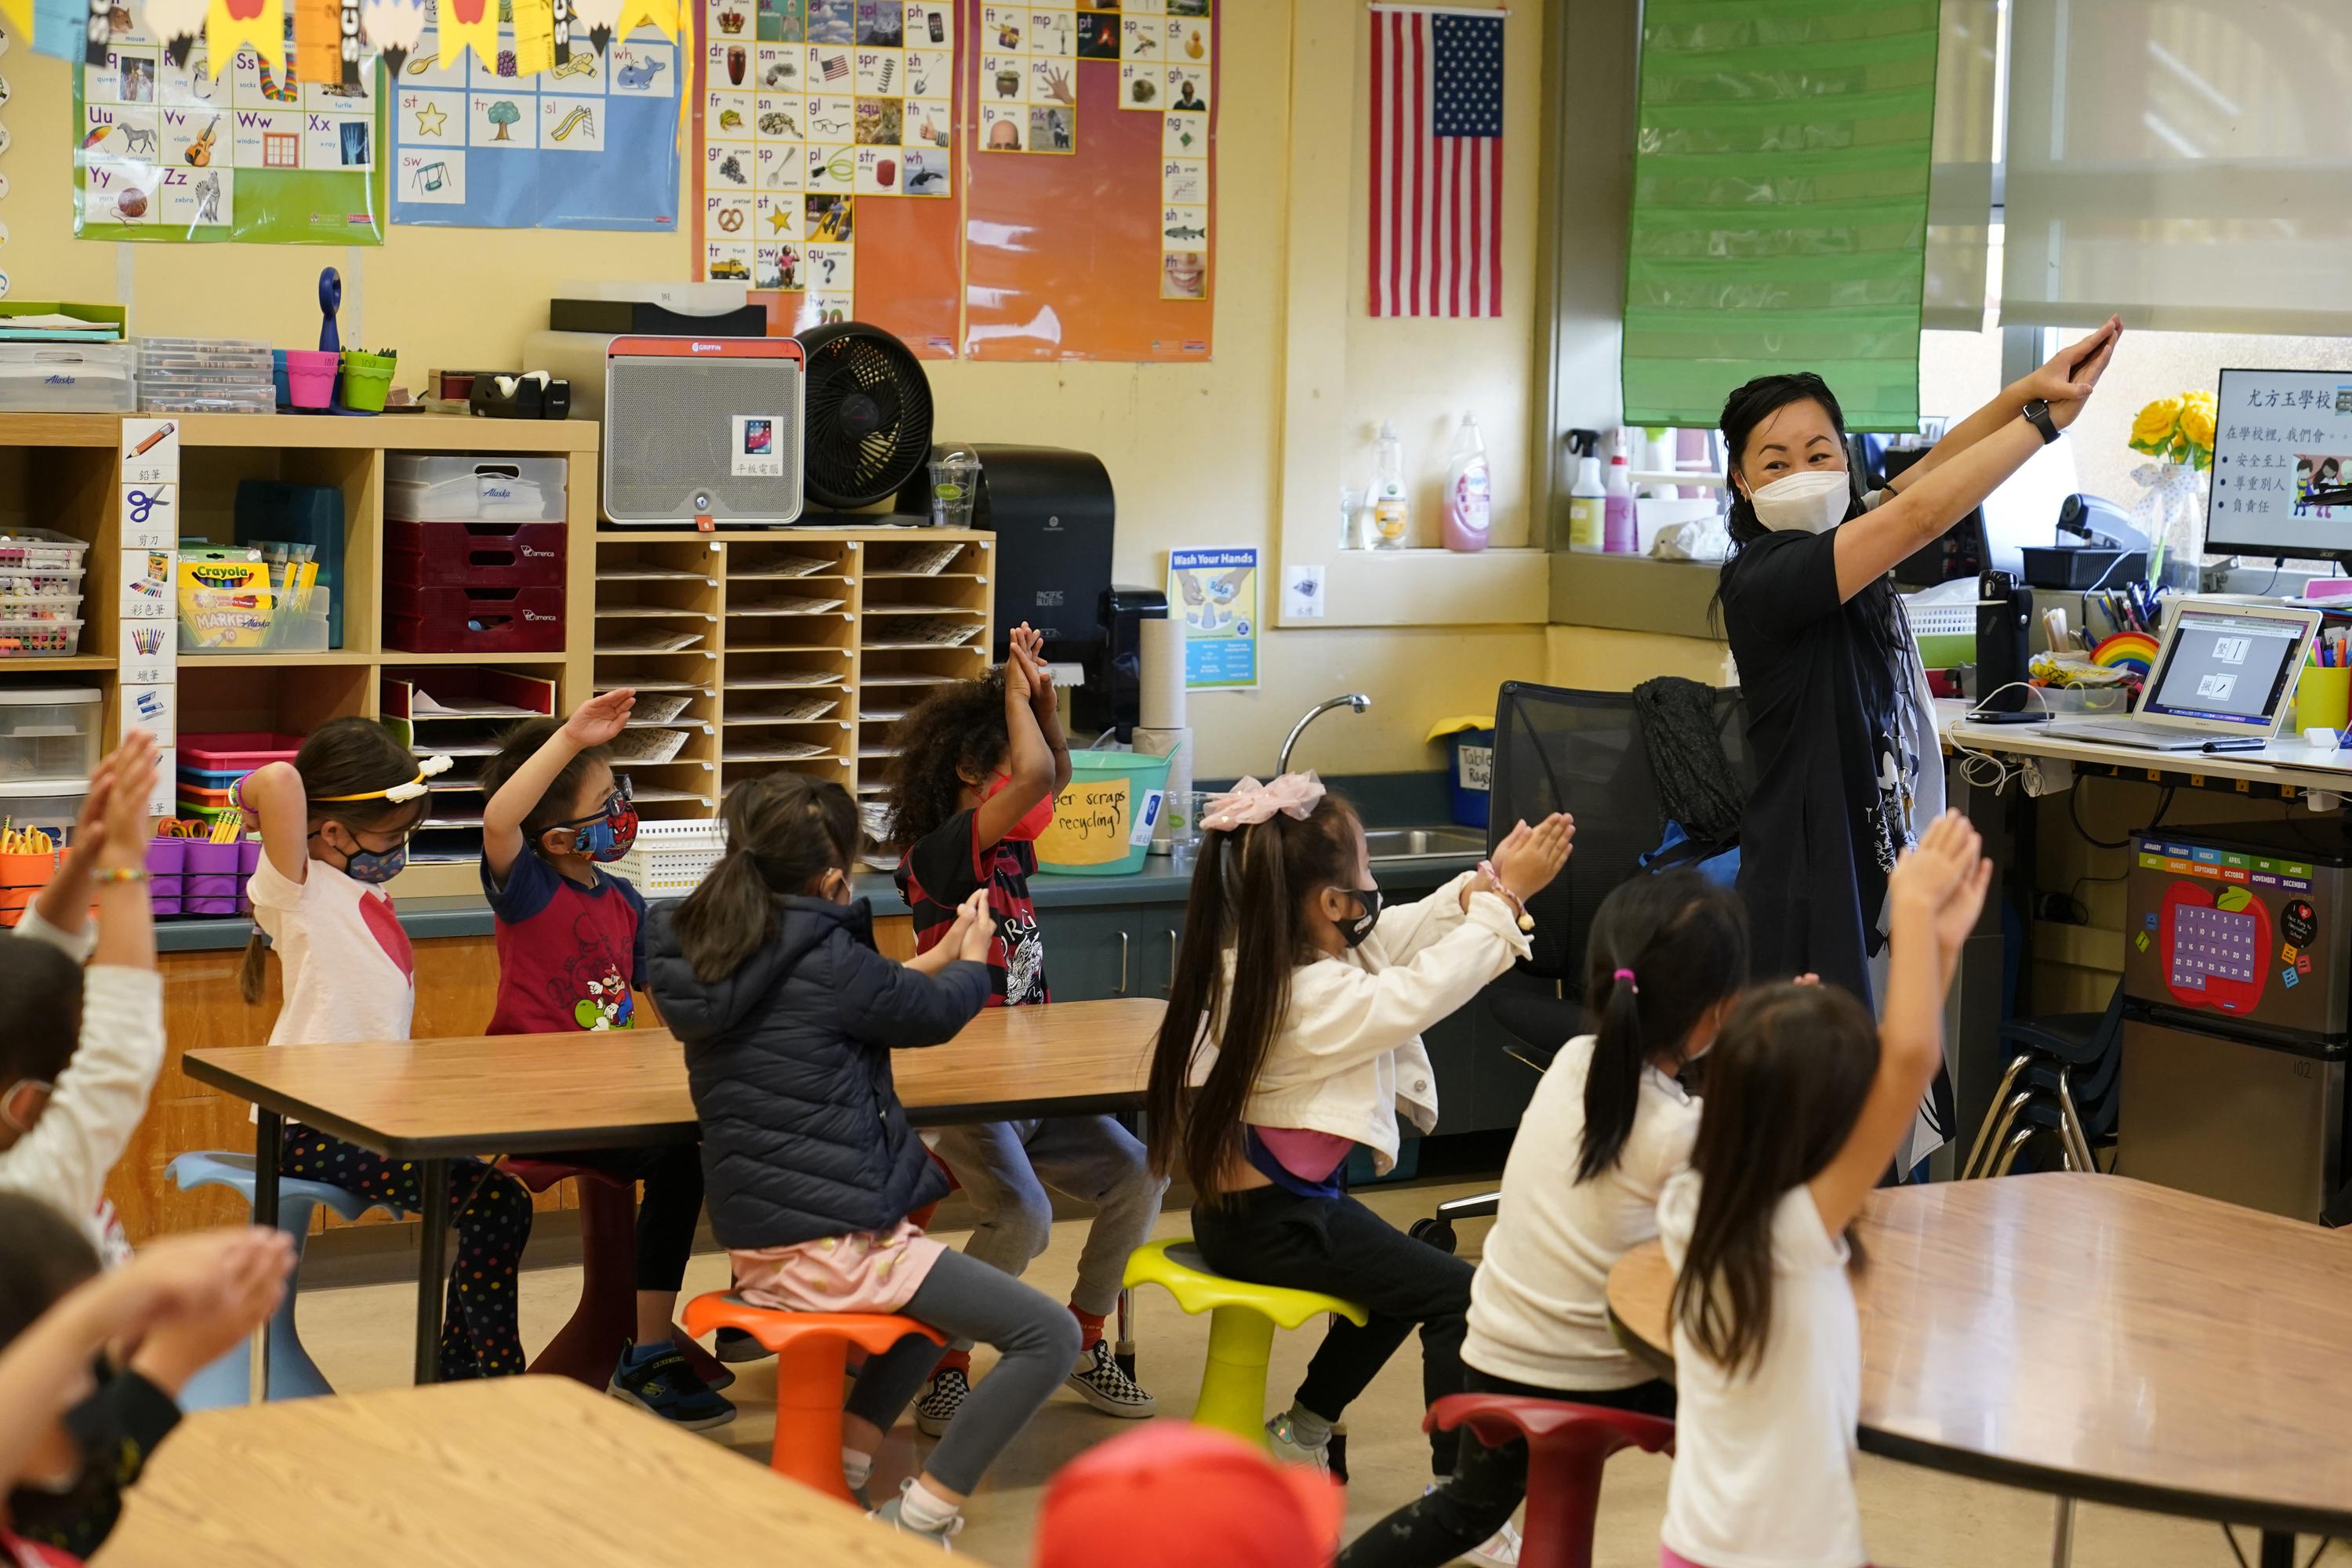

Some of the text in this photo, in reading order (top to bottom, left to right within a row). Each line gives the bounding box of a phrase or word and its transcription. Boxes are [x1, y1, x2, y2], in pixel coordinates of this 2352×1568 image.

[860, 3, 877, 19] spl
[908, 5, 923, 21] ph
[985, 9, 995, 22] ft
[1033, 15, 1051, 28] mp
[1079, 15, 1092, 31] pt
[1123, 20, 1137, 34] sp
[1168, 20, 1181, 33] ck
[614, 48, 632, 60] wh
[710, 43, 723, 57] dr
[760, 49, 775, 60] sm
[810, 49, 818, 61] fl
[237, 53, 254, 69] Ss
[858, 53, 878, 67] spr
[908, 53, 921, 67] sh
[985, 56, 996, 71] ld
[1033, 60, 1047, 73] nd
[1123, 65, 1134, 78] st
[1168, 67, 1183, 84] gh
[403, 96, 418, 108] st
[474, 99, 488, 111] tr
[710, 93, 721, 107] fr
[758, 99, 771, 109] sn
[809, 97, 820, 115] gl
[89, 106, 113, 124] Uu
[545, 102, 556, 114] sl
[857, 103, 878, 118] squ
[907, 101, 919, 115] th
[983, 106, 995, 122] lp
[1032, 107, 1046, 122] nk
[164, 109, 185, 126] Vv
[237, 111, 272, 129] Ww
[309, 114, 331, 132] Xx
[1167, 117, 1181, 131] ng
[708, 147, 723, 161] gr
[759, 149, 773, 163] sp
[810, 147, 821, 164] pl
[859, 149, 876, 163] str
[905, 151, 923, 164] wh
[403, 157, 422, 166] sw
[165, 168, 187, 185] Zz
[1166, 162, 1180, 177] ph
[89, 166, 111, 188] Yy
[708, 198, 721, 211] pr
[757, 195, 769, 209] st
[1165, 208, 1177, 221] sh
[709, 243, 720, 256] tr
[758, 249, 775, 258] sw
[808, 249, 823, 263] qu
[1166, 255, 1177, 268] th
[45, 374, 76, 386] Alaska
[2247, 389, 2332, 410] 尤方玉學校
[2236, 452, 2287, 468] 安全至上
[138, 469, 161, 481] 鉛筆
[737, 463, 779, 475] 平板電腦
[2234, 475, 2285, 492] 尊重別人
[483, 488, 511, 499] Alaska
[2233, 498, 2270, 513] 負責任
[138, 534, 158, 546] 剪刀
[1174, 552, 1254, 565] Wash Your Hands
[197, 565, 249, 578] Crayola
[131, 604, 165, 616] 彩色筆
[196, 612, 260, 631] MARKERS
[241, 619, 270, 628] Alaska
[1461, 748, 1492, 767] Table
[1053, 789, 1126, 812] per scraps
[2144, 843, 2161, 851] JANUARY
[2169, 847, 2189, 856] FEBRUARY
[2289, 866, 2302, 874] JUNE
[2194, 866, 2218, 875] SEPTEMBER
[2224, 870, 2244, 880] OCTOBER
[2252, 875, 2276, 884] NOVEMBER
[2283, 880, 2307, 890] DECEMBER
[2294, 1060, 2312, 1079] 102
